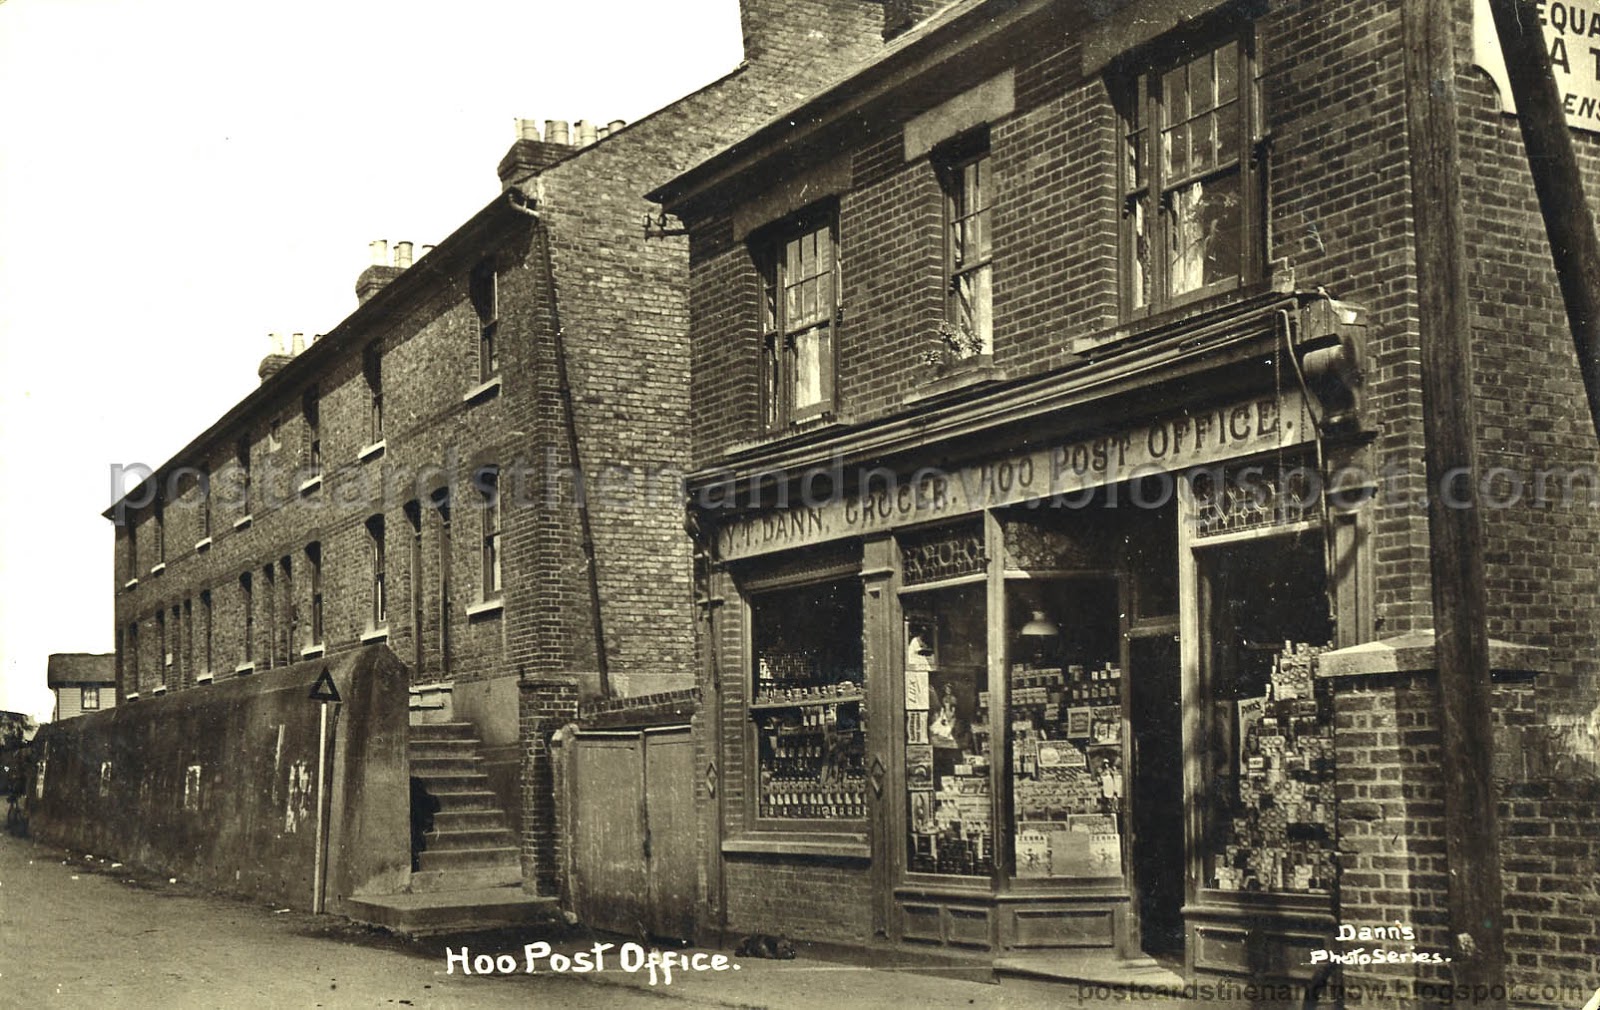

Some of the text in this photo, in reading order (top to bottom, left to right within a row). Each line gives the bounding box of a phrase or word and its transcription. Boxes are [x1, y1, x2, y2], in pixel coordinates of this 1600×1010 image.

[981, 457, 1034, 496] HOO
[1054, 433, 1131, 481] POST
[1147, 399, 1293, 458] OFFICE.
